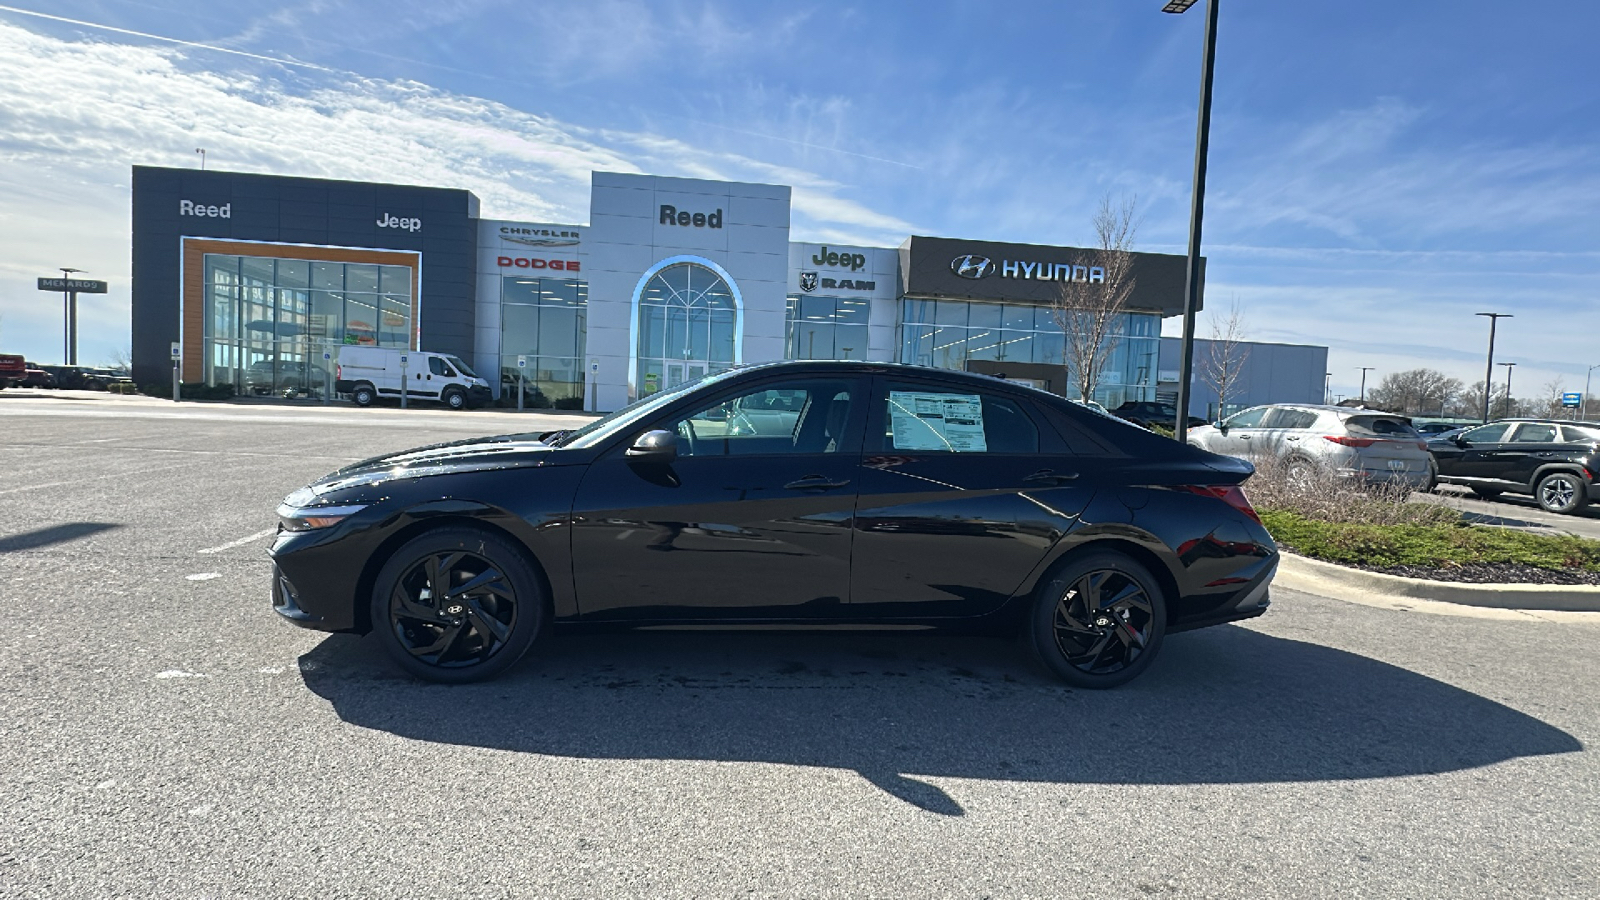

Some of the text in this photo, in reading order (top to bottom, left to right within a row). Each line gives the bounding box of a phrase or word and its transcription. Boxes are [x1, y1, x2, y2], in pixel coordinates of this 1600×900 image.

[180, 199, 231, 218] Reed
[660, 204, 723, 229] Reed
[376, 212, 422, 232] Jeep
[500, 227, 580, 239] CHRYSLER
[497, 256, 581, 272] DODGE
[812, 246, 866, 272] Jeep
[1002, 259, 1110, 284] HYUNDA
[821, 277, 876, 291] RAM
